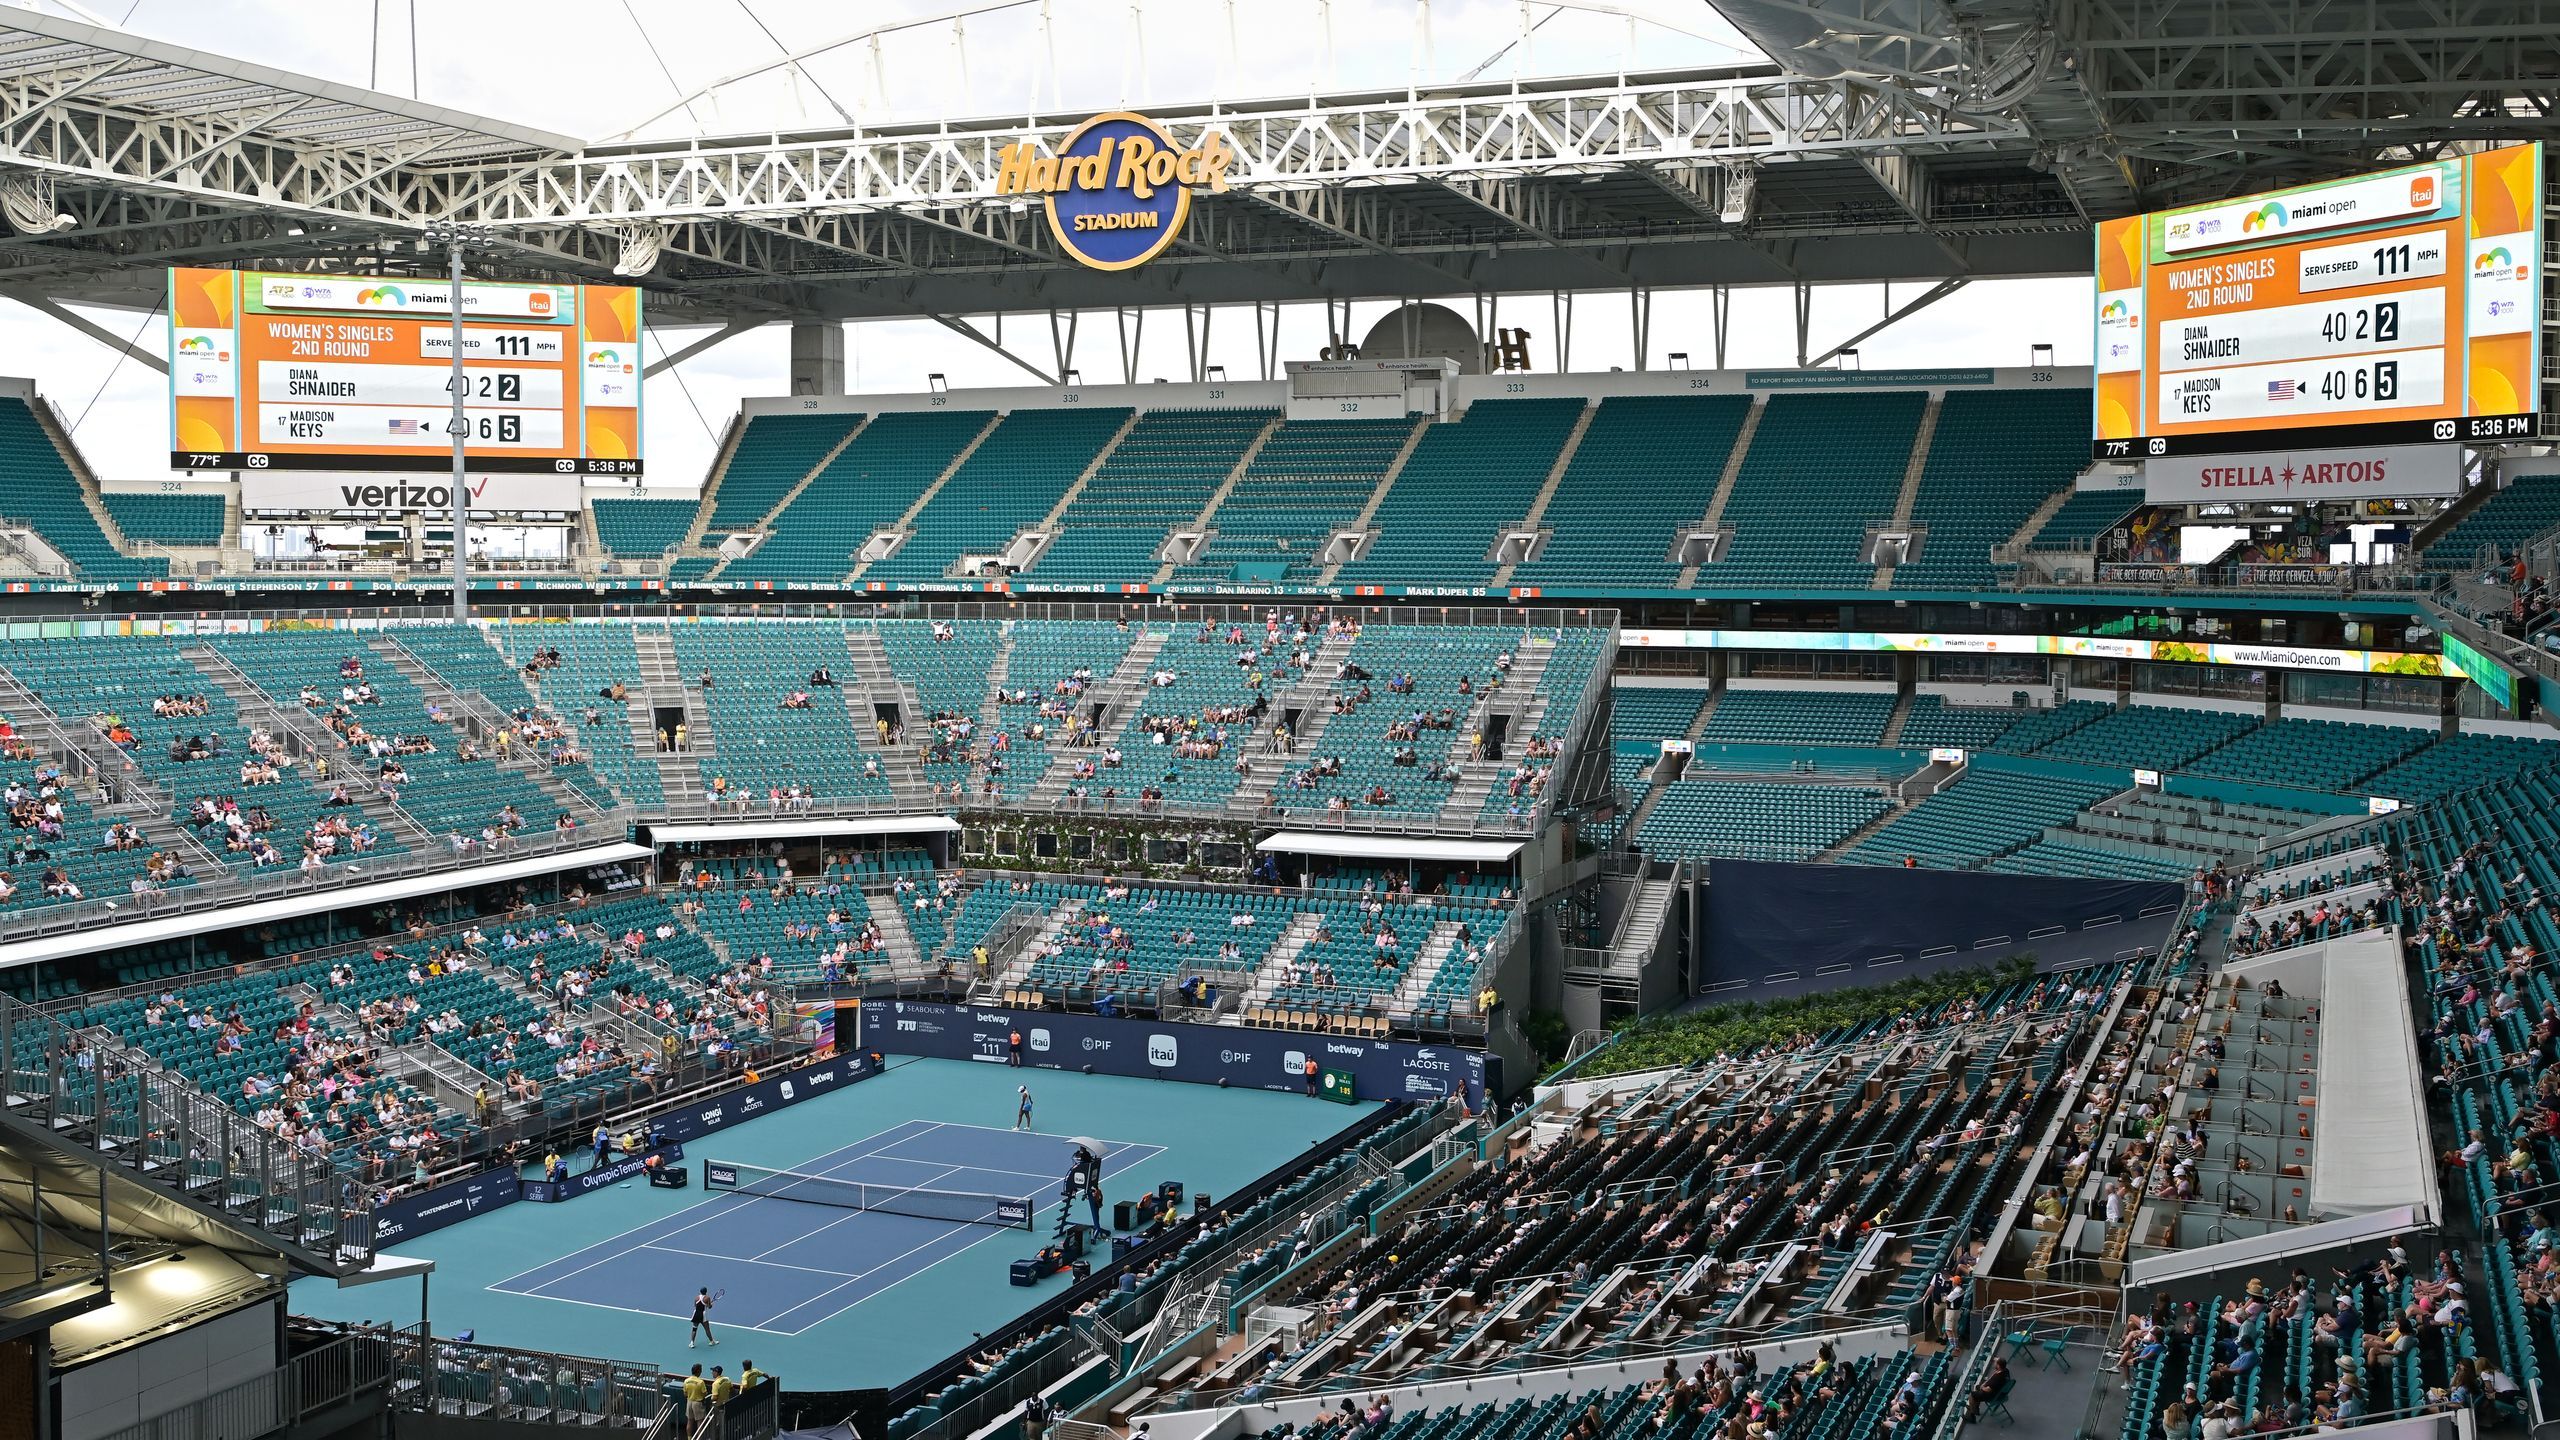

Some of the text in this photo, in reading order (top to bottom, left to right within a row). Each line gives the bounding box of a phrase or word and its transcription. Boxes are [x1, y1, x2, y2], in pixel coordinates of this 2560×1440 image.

[996, 131, 1233, 199] Hard Rock
[2412, 189, 2432, 203] itaú
[2292, 199, 2357, 219] miami open
[1074, 211, 1158, 232] STADIUM
[2305, 244, 2439, 277] SERVE SPEED 111 MPH
[2169, 257, 2275, 291] WOMEN'S SINGLES
[2474, 269, 2495, 278] miami
[2496, 268, 2512, 277] open
[412, 293, 447, 303] miami
[2187, 283, 2253, 309] 2ND ROUND
[269, 323, 394, 342] WOMEN'S SINGLES
[2184, 305, 2393, 361] SHNAIDER 40 2 2
[2184, 326, 2208, 341] DIANA
[292, 340, 370, 357] 2ND ROUND
[426, 339, 452, 347] SERVE
[459, 340, 481, 348] PEED
[495, 336, 529, 356] 111
[290, 369, 318, 380] DIANA
[2031, 372, 2053, 382] 336
[289, 381, 356, 397] SHNAIDER
[479, 376, 491, 398] 2
[503, 377, 516, 398] 2
[1507, 383, 1525, 393] 333
[1690, 379, 1709, 389] 334
[2174, 366, 2392, 400] 17 MADISON 40 6 5
[1063, 394, 1078, 403] 330
[1209, 390, 1225, 399] 331
[803, 400, 818, 410] 328
[931, 397, 946, 407] 329
[2183, 394, 2211, 414] KEYS
[1340, 404, 1358, 412] 332
[278, 417, 286, 426] 17
[290, 411, 334, 422] MADISON
[480, 418, 492, 439] 6
[503, 418, 516, 440] 5
[290, 423, 323, 438] KEYS
[2471, 419, 2528, 436] 5:36 PM
[2106, 442, 2129, 455] 77°F
[189, 455, 221, 466] 77°F
[588, 462, 636, 472] 5:36 PM
[2200, 459, 2386, 488] STELLA ARTOIS
[2118, 475, 2133, 487] 337
[161, 482, 182, 492] 324
[630, 488, 648, 497] 327
[2113, 528, 2128, 539] VEZA
[2297, 536, 2312, 546] VEZA
[2297, 547, 2312, 558] SUR
[51, 582, 119, 592] LARRY LITTLE 66
[195, 582, 319, 591] DWIGHT STEPHENSON 57
[373, 582, 391, 590] BOB
[536, 581, 627, 590] RICHMOND WEBB 78
[672, 581, 746, 590] BOB BAUMHOWER 73
[788, 582, 852, 591] DOUG BETTERS 75
[896, 583, 973, 592] JOHN OFFERDAHL 56
[1026, 584, 1106, 592] MARK CLAYTON 83
[1216, 586, 1284, 595] DAN MARINO 13
[1406, 586, 1486, 596] MARK DUPER 85
[1945, 639, 1984, 648] miami open
[2234, 650, 2341, 667] www.MiamiOpen.com
[907, 1005, 945, 1014] SEABOURN
[977, 1013, 1010, 1026] betway
[897, 1020, 917, 1031] FIU
[982, 1043, 999, 1055] 111
[1095, 1040, 1111, 1050] PIF
[1327, 1043, 1364, 1057] betway
[1151, 1048, 1174, 1061] itaú
[1234, 1053, 1251, 1063] PIF
[1286, 1061, 1303, 1070] itaú
[1403, 1059, 1450, 1071] LACOSTE
[809, 1071, 834, 1086] betway
[1472, 1070, 1478, 1078] 12
[741, 1101, 764, 1113] LACOSTE
[712, 1169, 735, 1178] HOLOGIC
[529, 1193, 545, 1201] SERVE
[417, 1199, 463, 1218] WTATENNIS.COM
[999, 1206, 1025, 1214] HOLOGIC
[375, 1224, 404, 1240] ACOSTE
